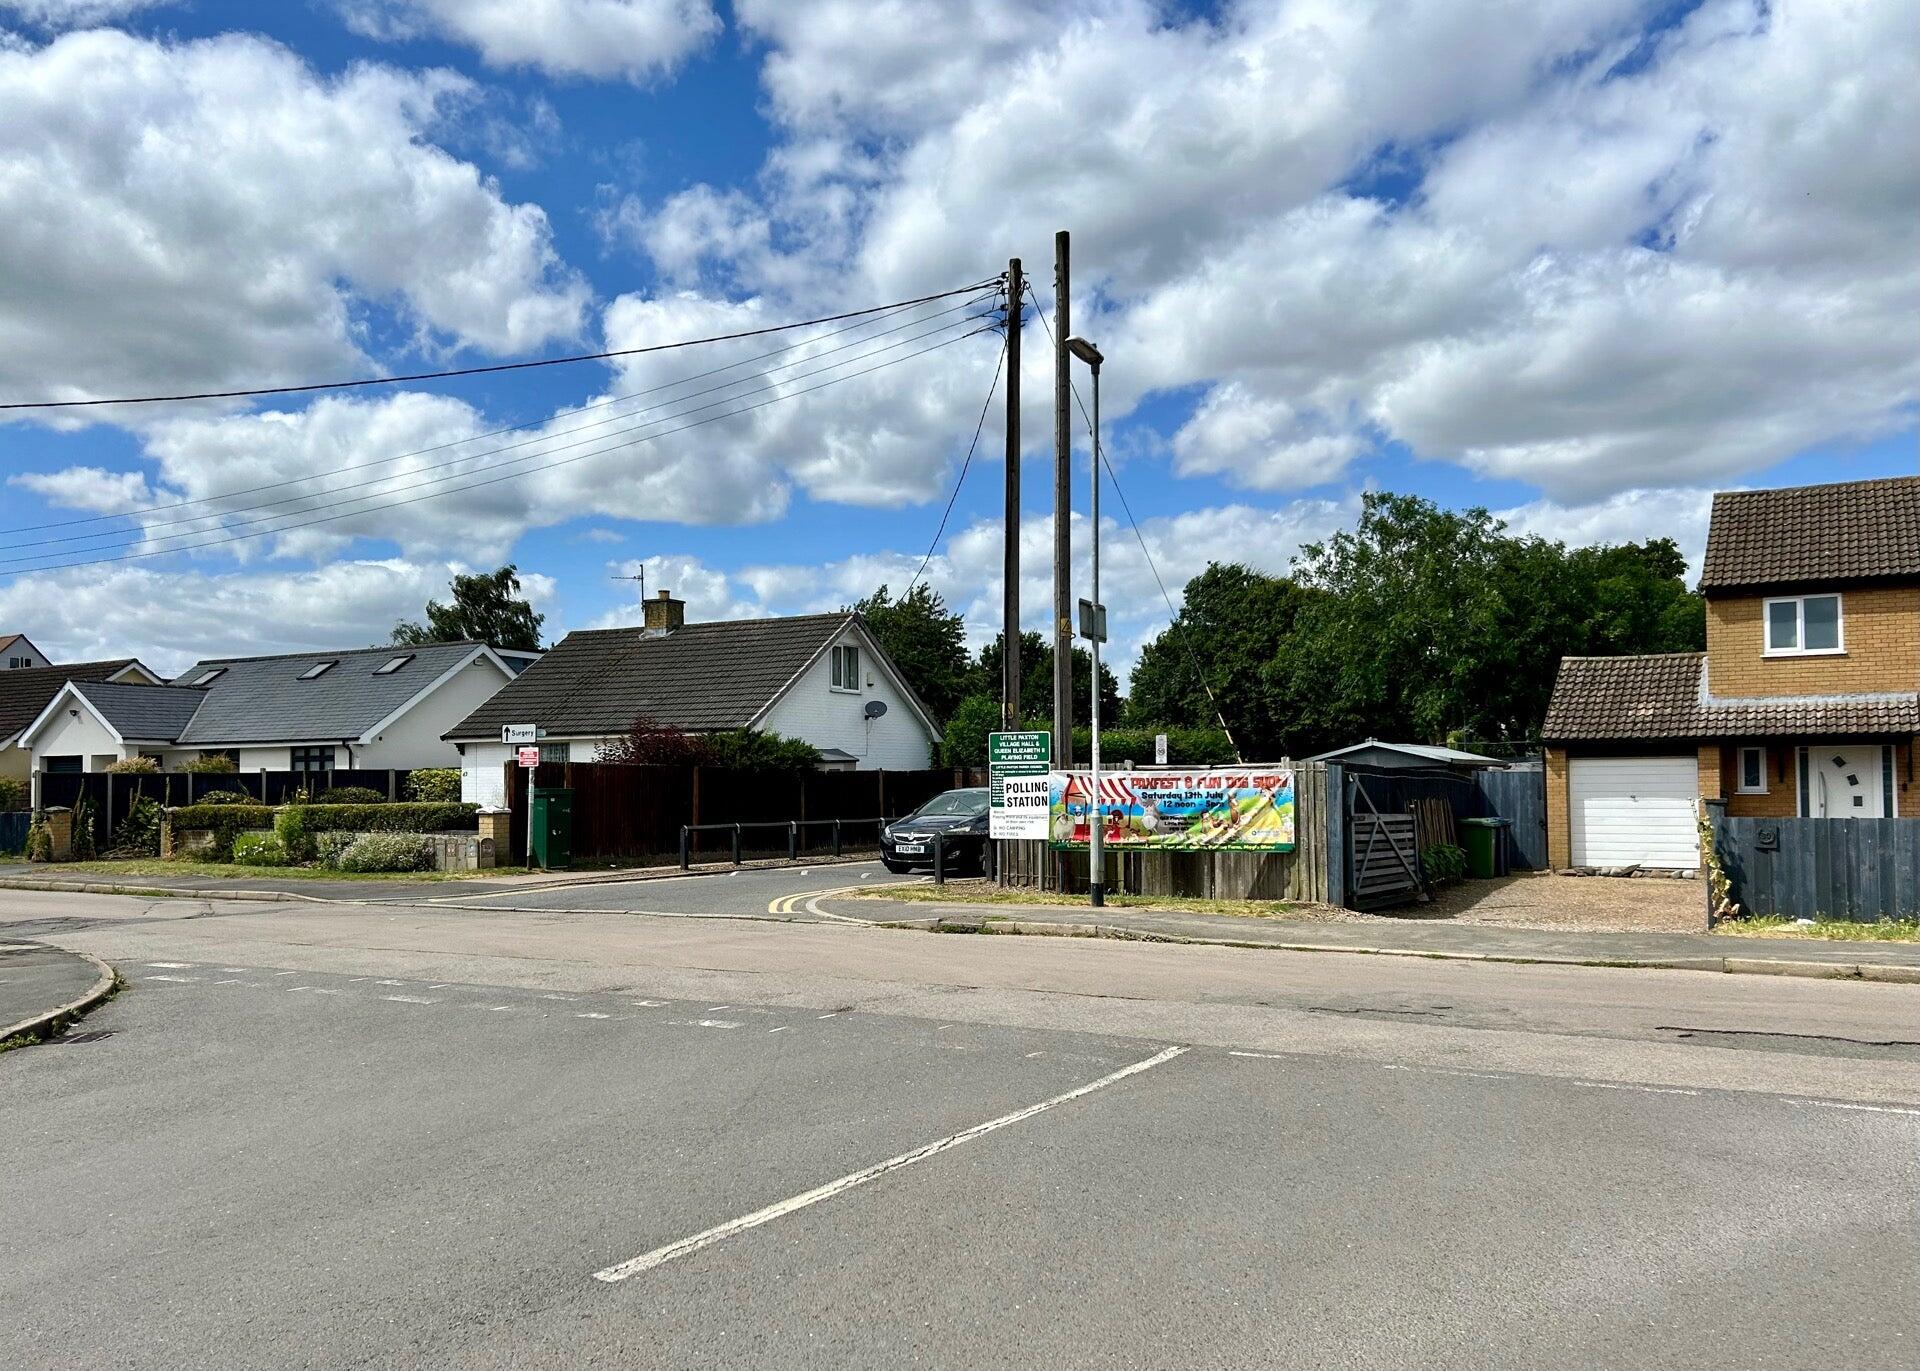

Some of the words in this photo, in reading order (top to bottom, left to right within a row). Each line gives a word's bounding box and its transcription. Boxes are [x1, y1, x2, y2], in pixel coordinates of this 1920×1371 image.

[511, 729, 534, 738] Surgery
[1006, 781, 1048, 793] POLLING
[1197, 776, 1221, 789] FUN
[1225, 776, 1248, 789] DOG
[1252, 775, 1288, 789] SHOW
[1141, 791, 1183, 801] Saturday
[1184, 791, 1203, 799] 13th
[1204, 791, 1224, 801] July
[1007, 796, 1048, 808] STATION
[1163, 800, 1172, 808] 12
